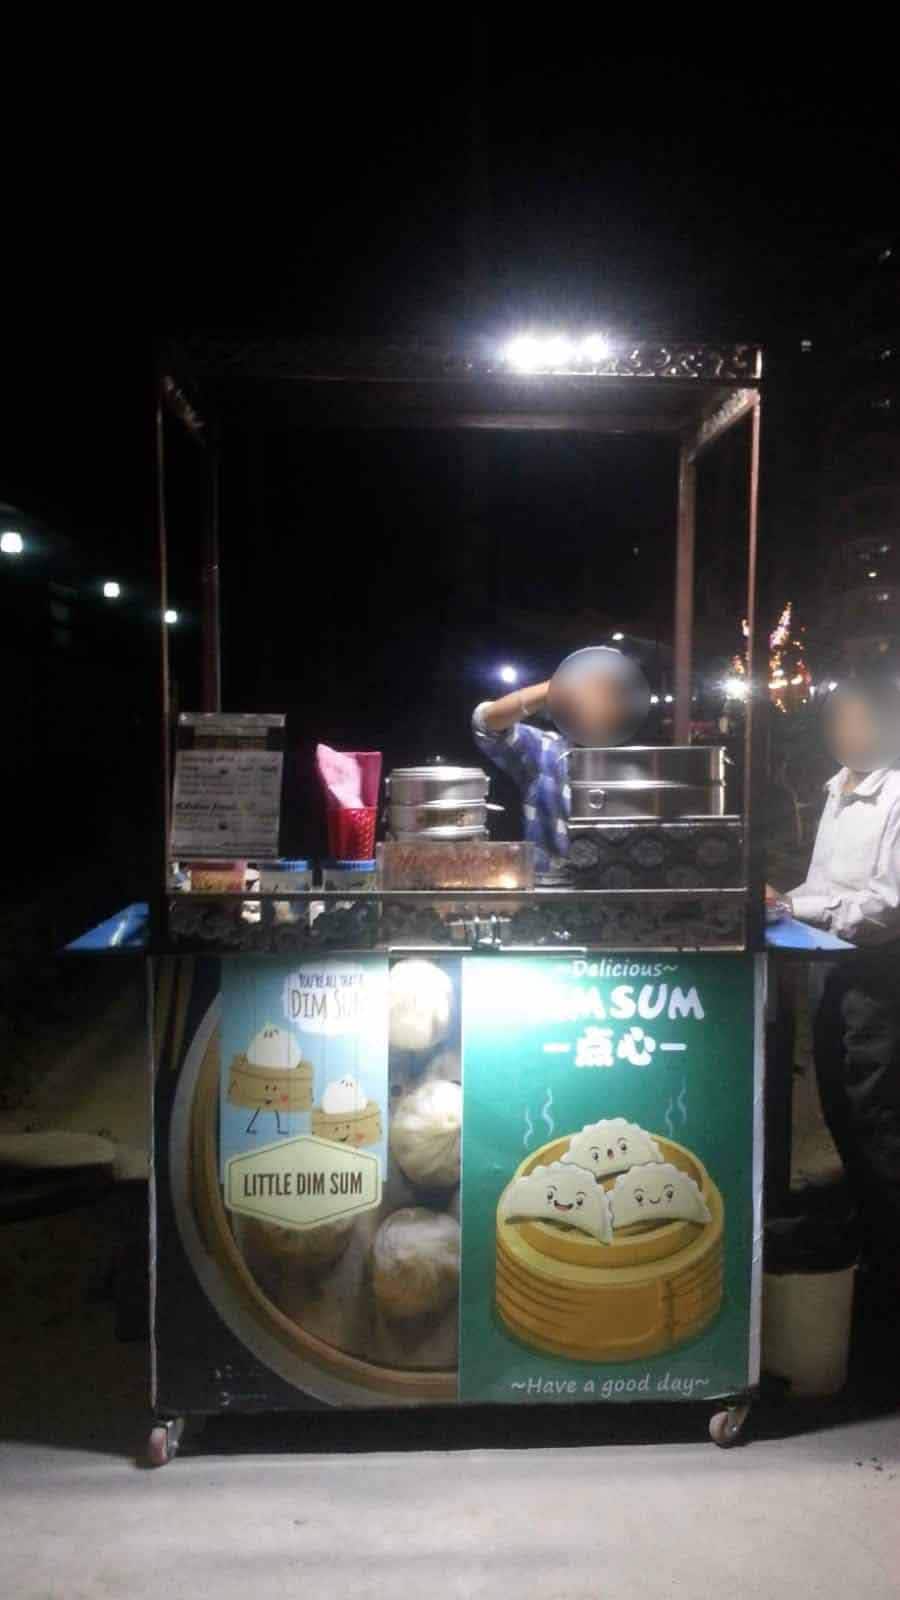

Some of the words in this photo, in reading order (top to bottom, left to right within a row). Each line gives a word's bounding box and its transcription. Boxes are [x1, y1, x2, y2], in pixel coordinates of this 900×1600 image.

[291, 989, 328, 1020] DIM
[243, 1173, 293, 1197] LITTLE
[296, 1172, 325, 1195] DIM
[330, 1171, 363, 1194] SUM
[583, 1382, 595, 1393] a
[602, 1373, 650, 1399] good
